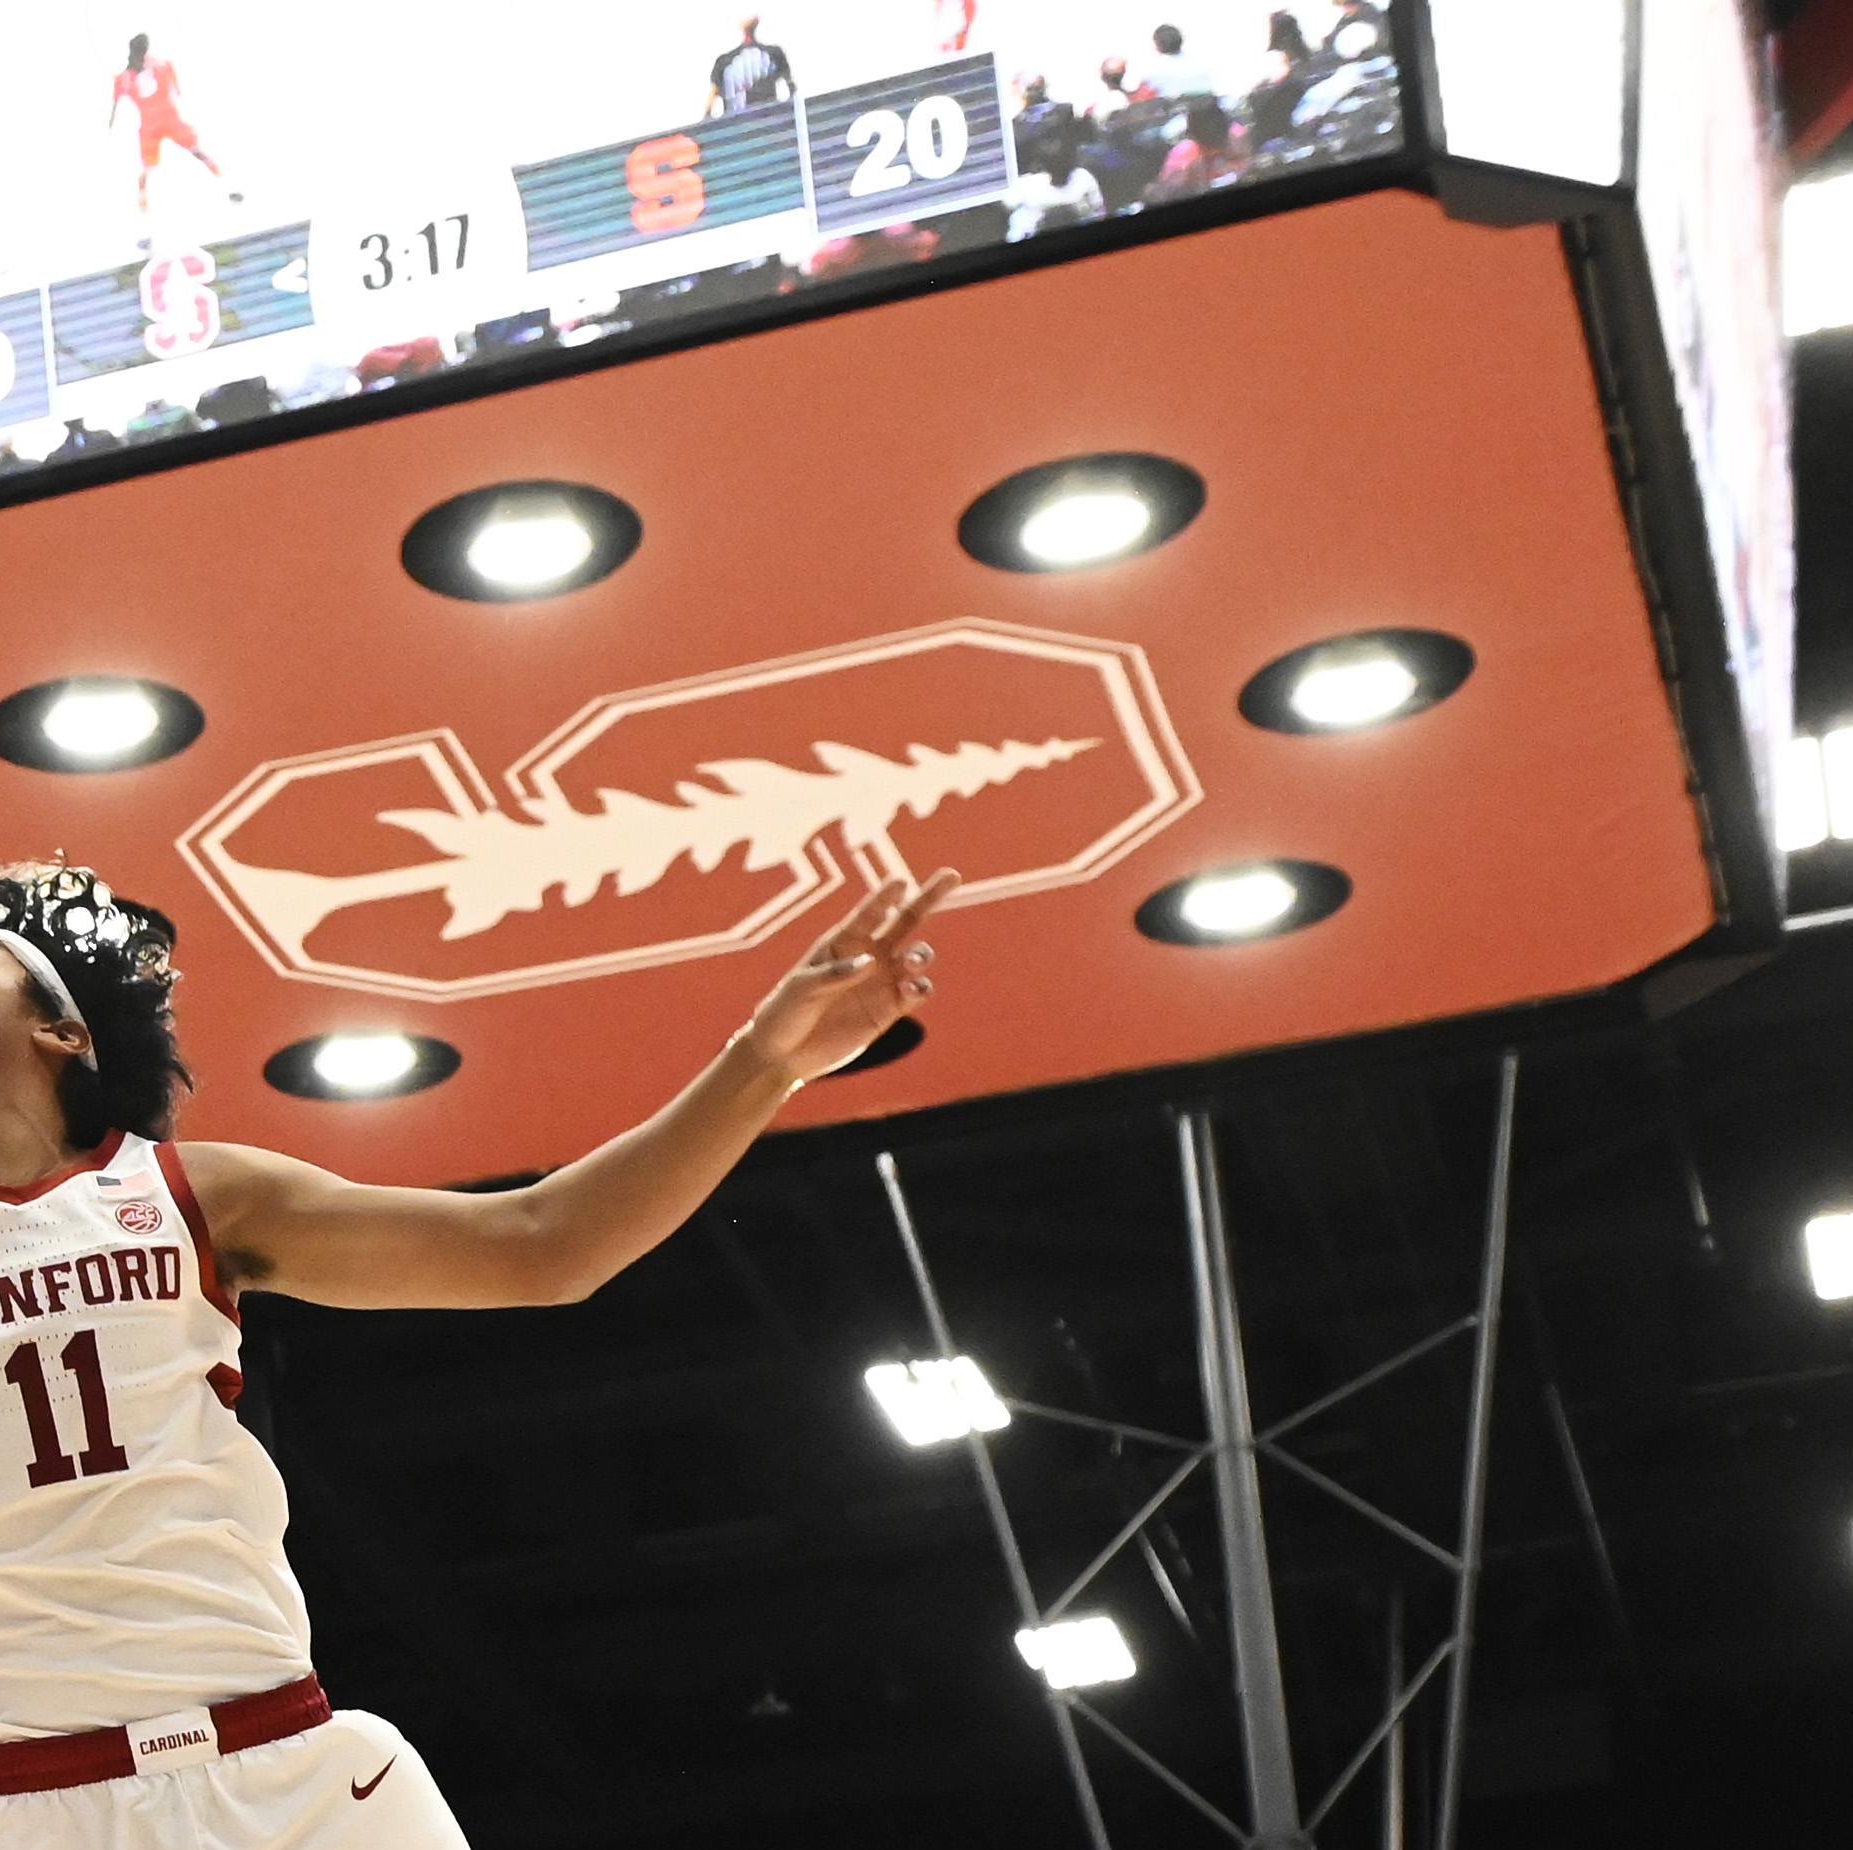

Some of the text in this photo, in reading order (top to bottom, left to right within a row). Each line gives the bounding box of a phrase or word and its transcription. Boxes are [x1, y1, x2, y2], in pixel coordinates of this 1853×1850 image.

[846, 95, 969, 197] 20
[360, 213, 470, 291] 3:17
[4, 1329, 130, 1488] 11
[139, 1729, 210, 1756] CARDINAL
